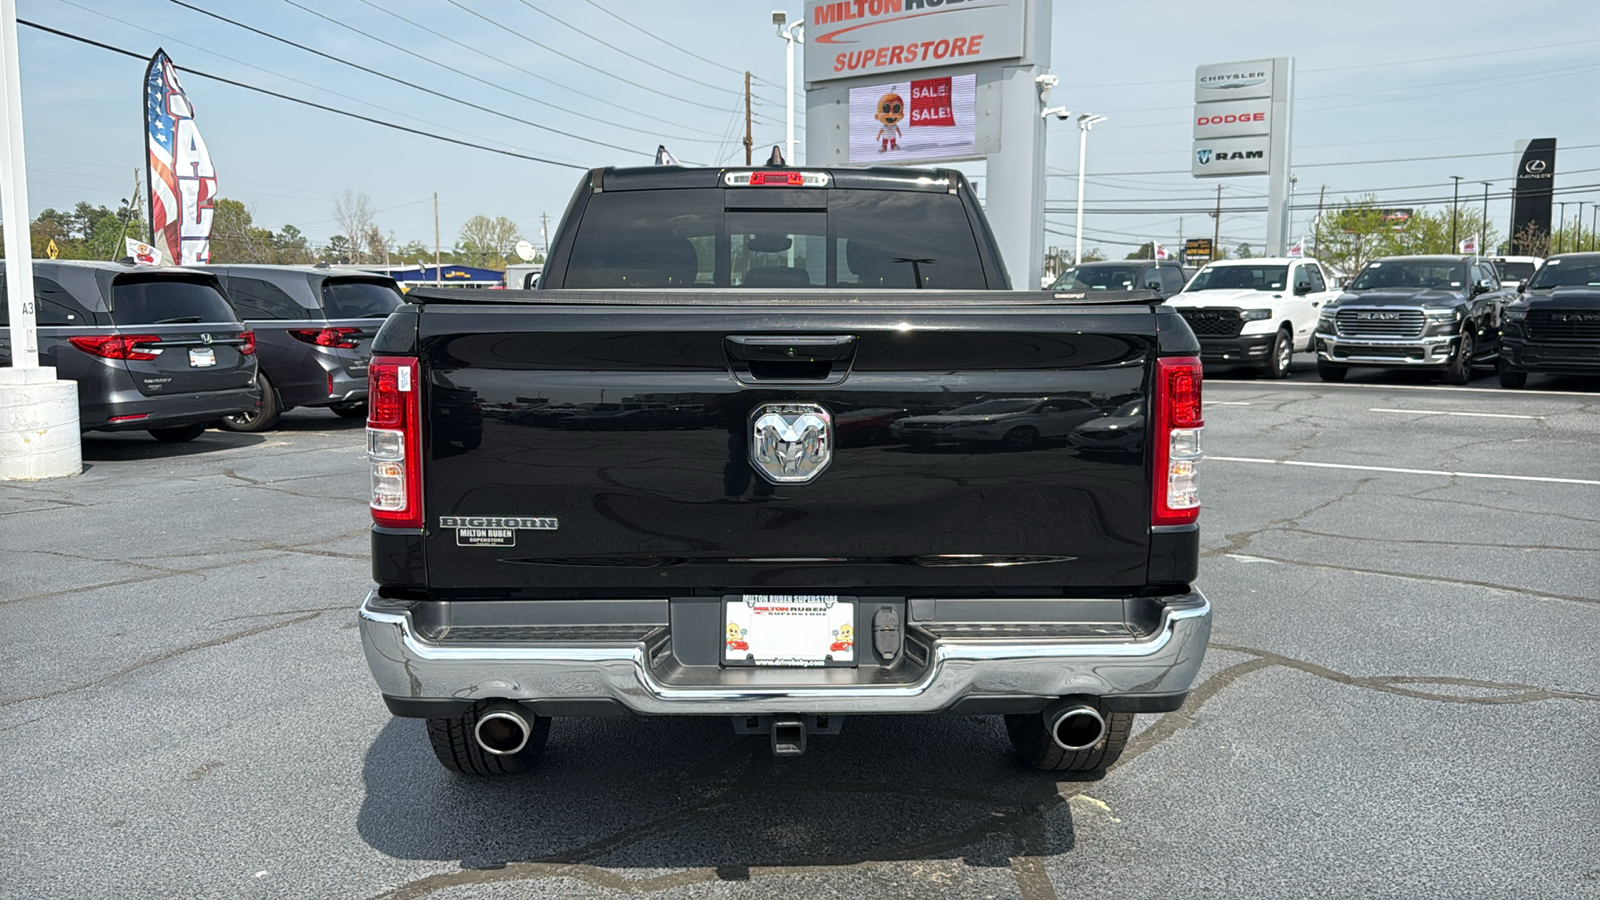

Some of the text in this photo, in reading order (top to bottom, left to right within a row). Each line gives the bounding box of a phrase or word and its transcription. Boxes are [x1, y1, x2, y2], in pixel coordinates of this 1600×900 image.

[814, 0, 902, 25] MILTON
[833, 35, 984, 72] SUPERSTORE
[1200, 72, 1265, 83] CHRYSLER
[912, 107, 951, 121] SALE!
[1197, 112, 1265, 126] DODGE
[1215, 150, 1263, 161] RAM
[22, 301, 34, 315] A3
[1357, 312, 1400, 320] RAM
[439, 516, 559, 529] BIGHORN
[460, 529, 512, 537] MILTON RUBEN
[743, 595, 838, 603] MILTON RUBEN SUPERSTORE
[755, 658, 825, 667] www.drivebaby.com
